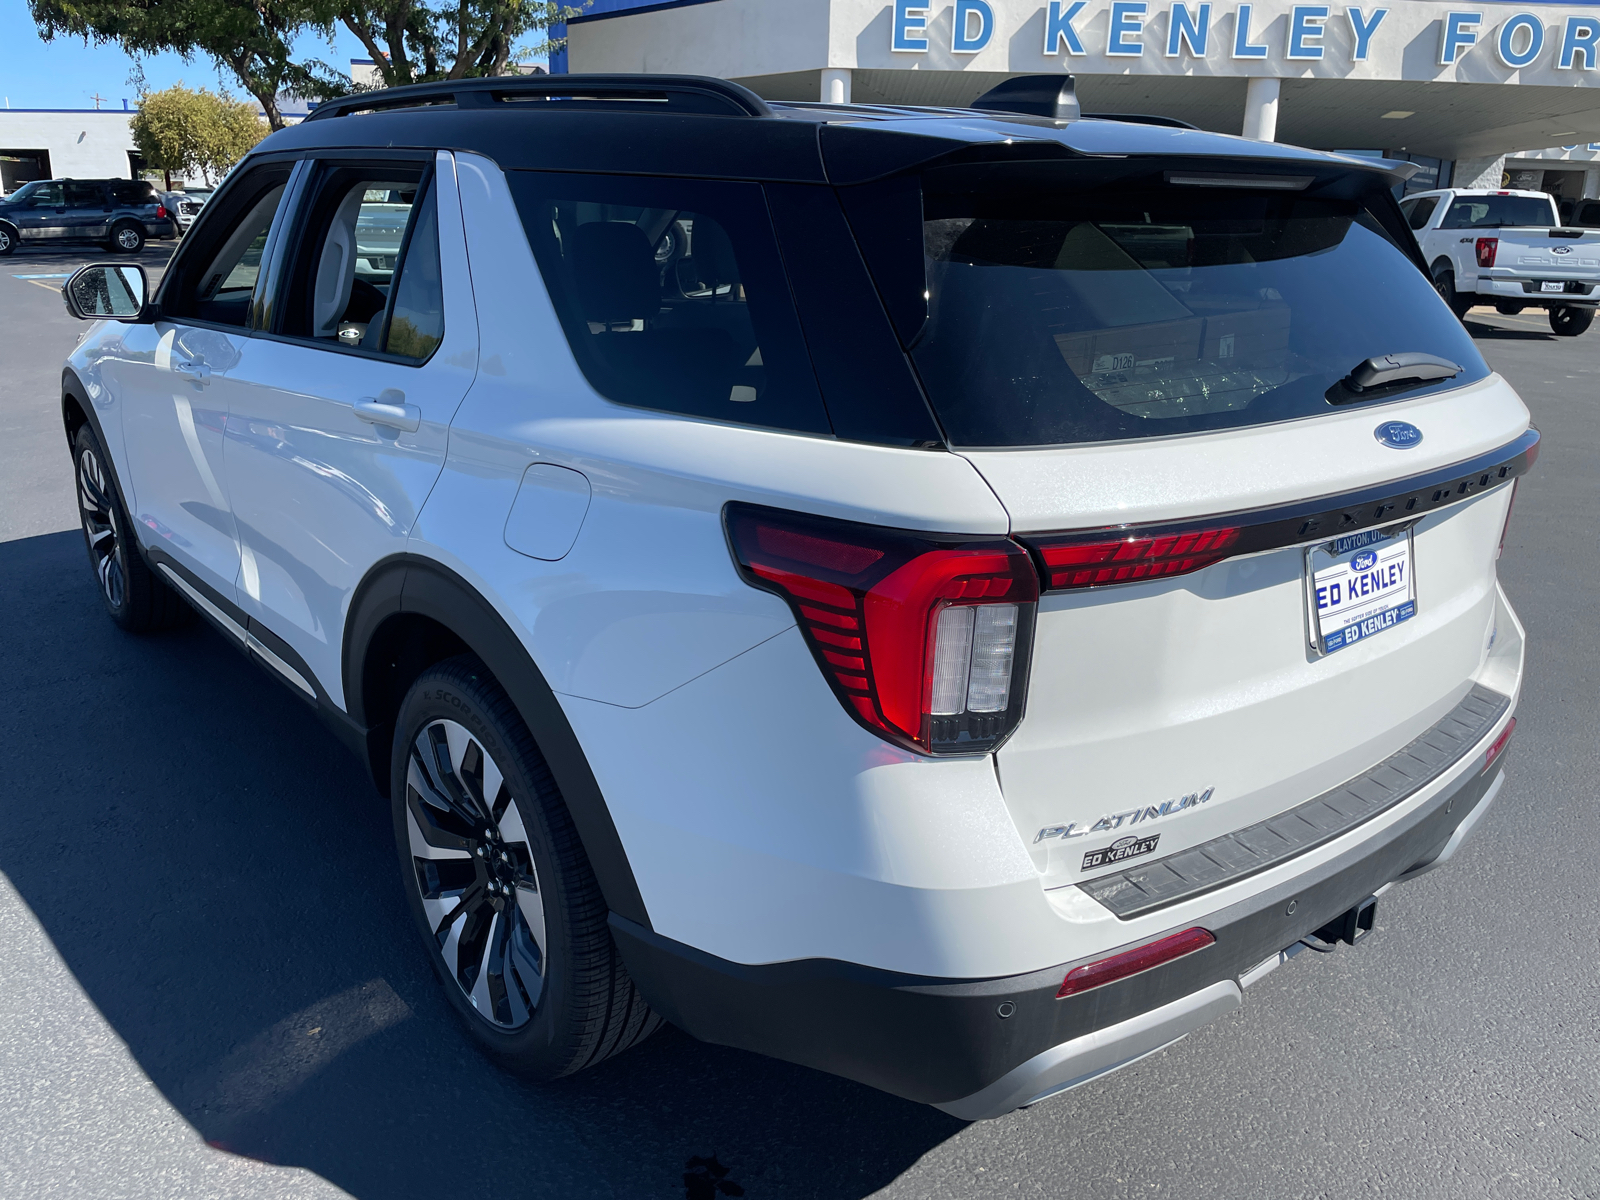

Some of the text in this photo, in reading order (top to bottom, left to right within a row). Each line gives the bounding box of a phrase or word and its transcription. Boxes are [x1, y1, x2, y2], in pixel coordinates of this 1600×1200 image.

[890, 0, 1600, 70] ED KENLEY FOR
[1517, 256, 1600, 267] F-150
[1112, 355, 1133, 370] D126
[1388, 424, 1417, 442] Ford
[1297, 465, 1513, 536] EXPLORER
[1355, 553, 1375, 571] Ford
[1316, 560, 1405, 609] ED KENLEY
[1344, 608, 1398, 644] ED KENLEY
[435, 689, 507, 763] SCORPION
[1033, 785, 1215, 844] PLATINUM
[1083, 838, 1158, 868] ED KENLEY
